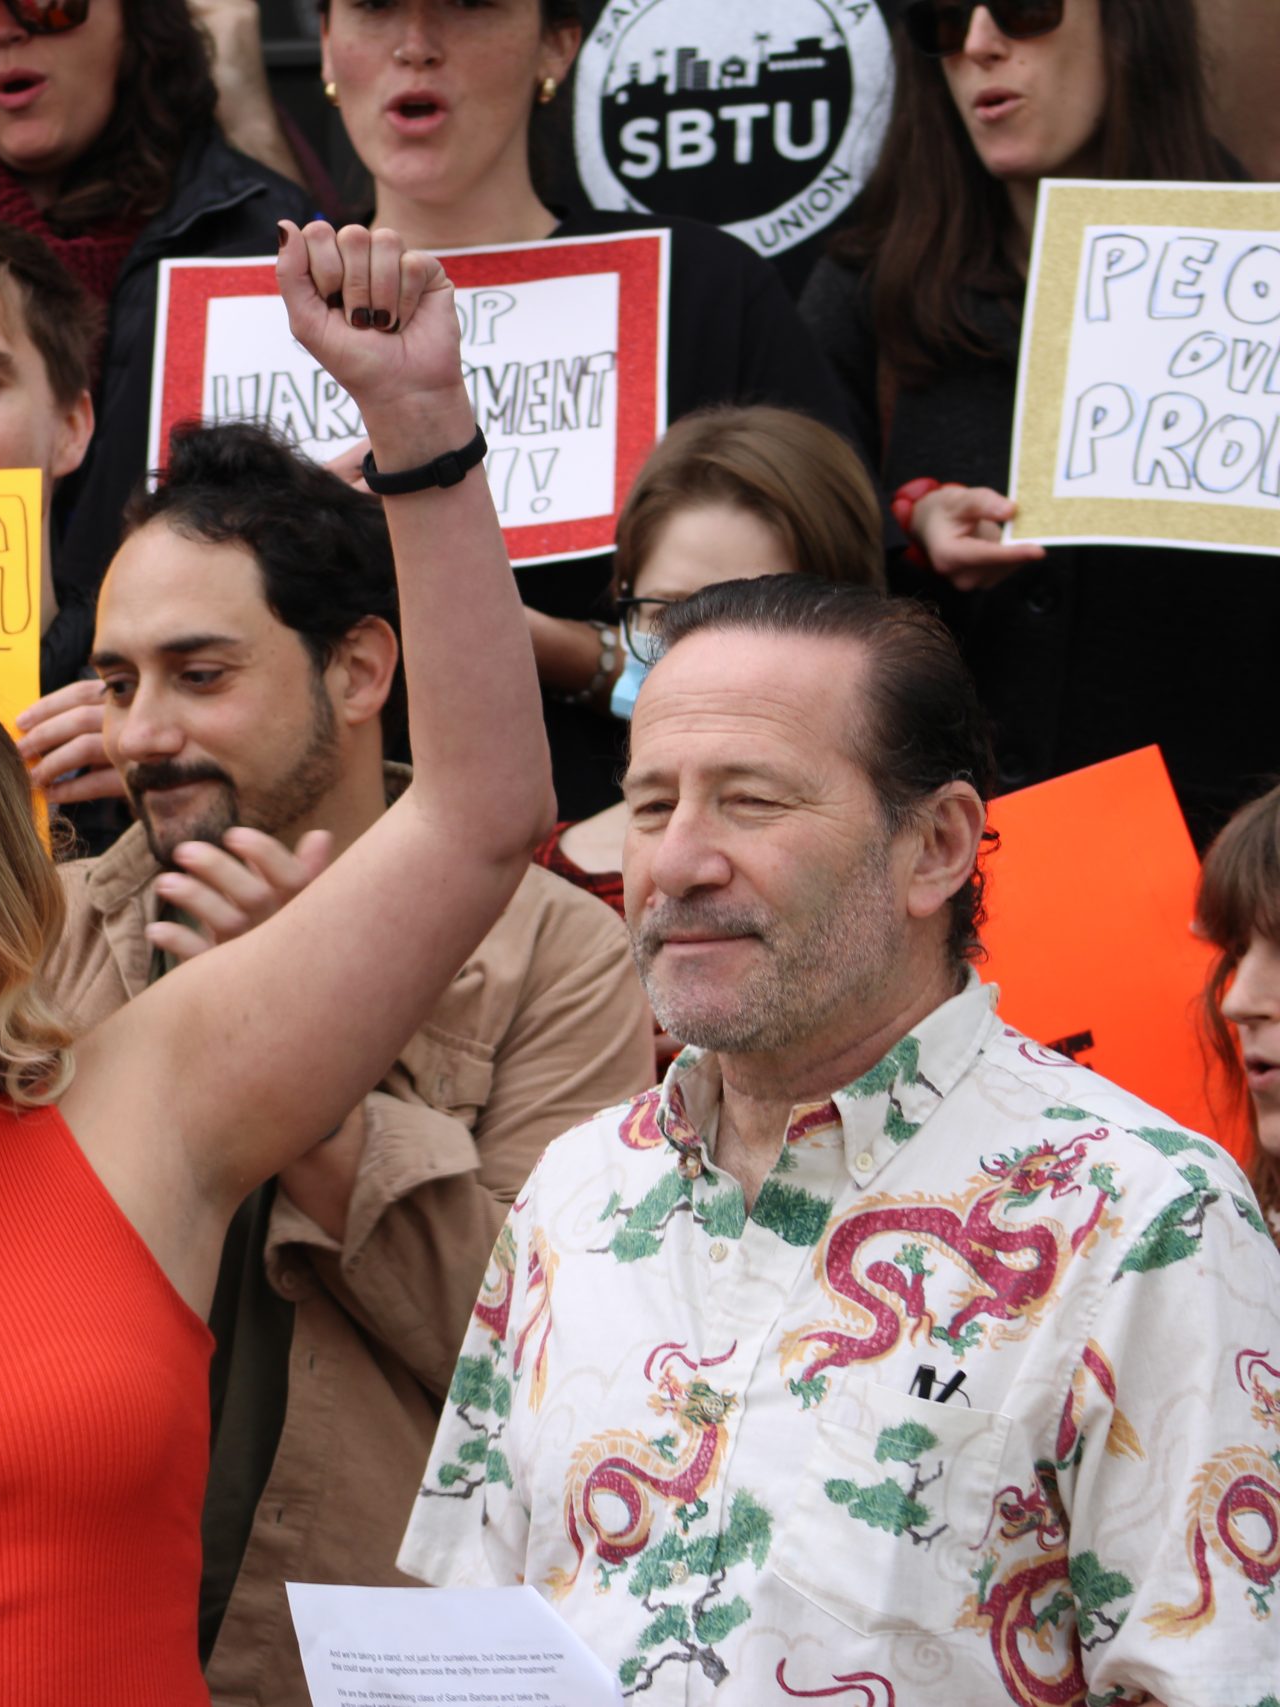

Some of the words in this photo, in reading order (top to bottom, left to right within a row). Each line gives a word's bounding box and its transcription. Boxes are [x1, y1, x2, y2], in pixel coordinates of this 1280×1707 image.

[620, 99, 830, 178] SBTU
[754, 164, 852, 249] UNION
[1169, 331, 1280, 394] OV
[329, 1649, 341, 1658] And
[404, 1654, 415, 1662] not
[430, 1653, 441, 1662] for
[481, 1653, 494, 1661] but
[495, 1653, 528, 1661] because
[542, 1652, 564, 1660] know
[343, 1664, 358, 1673] could
[385, 1667, 419, 1677] neighbors
[444, 1667, 457, 1675] the
[458, 1667, 472, 1677] city
[473, 1666, 490, 1675] from
[491, 1666, 516, 1675] similar
[337, 1688, 347, 1697] We
[348, 1690, 357, 1698] are
[358, 1690, 368, 1699] the
[392, 1692, 416, 1703] working
[417, 1694, 434, 1702] class
[444, 1692, 467, 1702] Santa
[468, 1692, 499, 1702] Barbara
[500, 1693, 515, 1702] and
